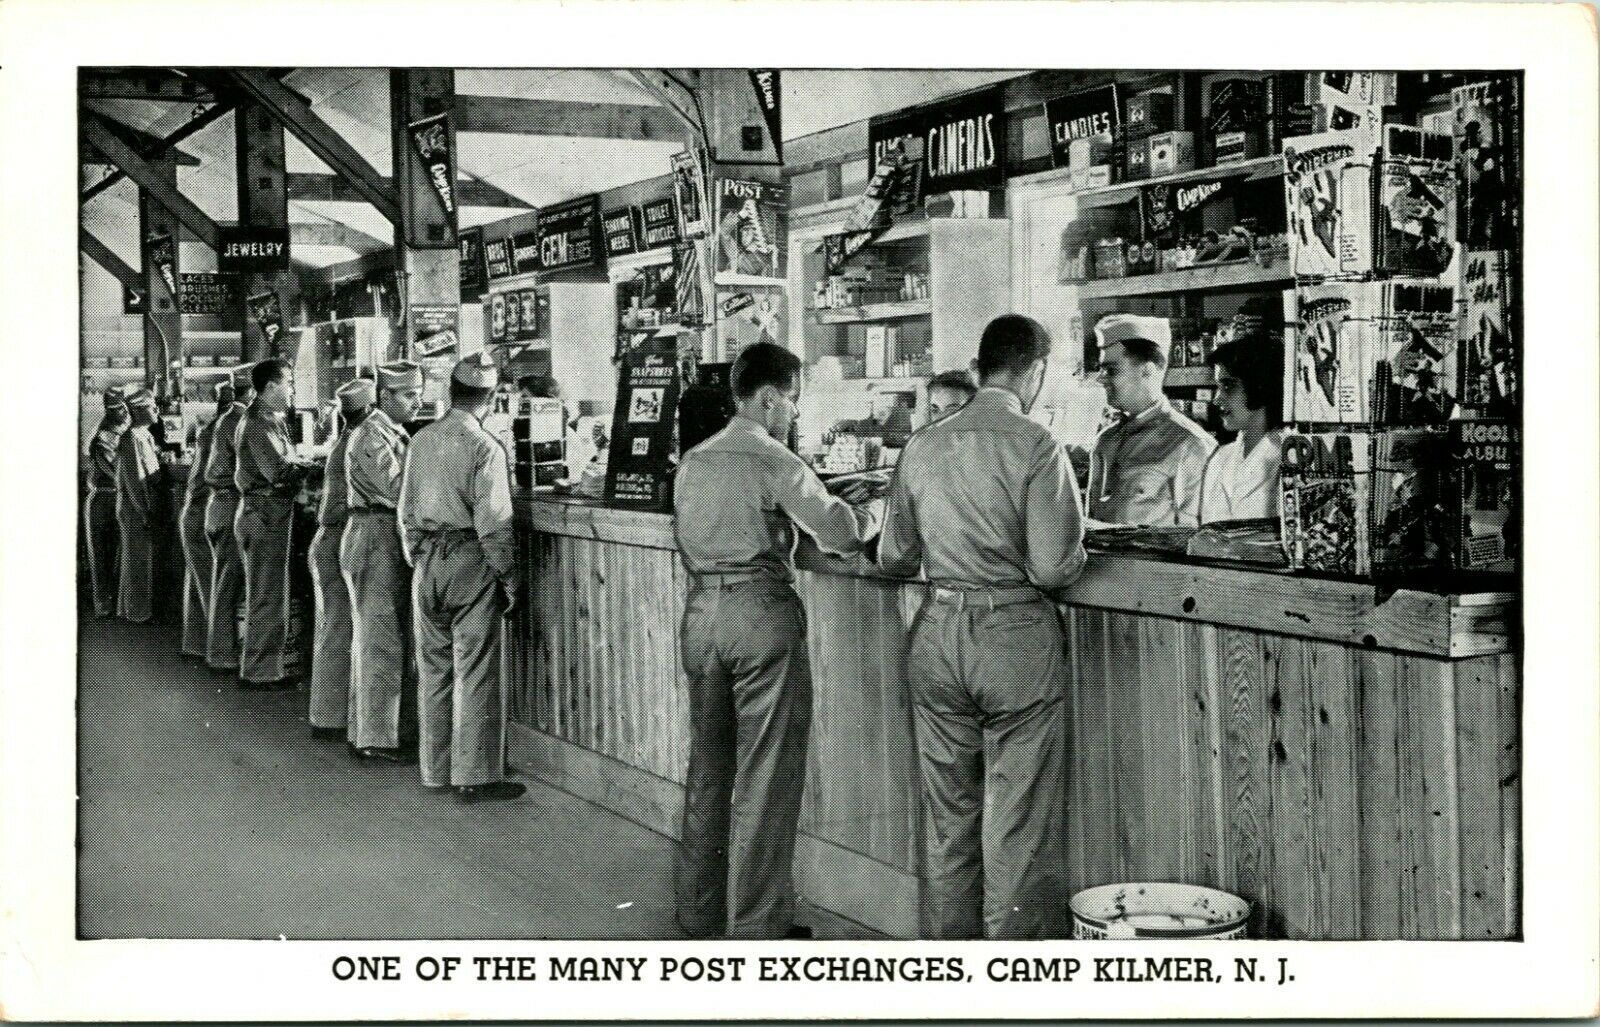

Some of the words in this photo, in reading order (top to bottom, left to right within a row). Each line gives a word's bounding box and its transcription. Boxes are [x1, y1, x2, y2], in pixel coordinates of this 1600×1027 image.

[1055, 112, 1110, 143] CANDIES
[928, 113, 995, 177] CAMERAS
[724, 178, 763, 200] POST
[647, 203, 670, 222] TOILET
[605, 215, 630, 234] SHAVING
[610, 234, 630, 251] NEEDS
[647, 225, 676, 244] ARTICLES
[223, 243, 284, 257] JEWELRY
[541, 231, 568, 267] GEM
[180, 274, 215, 284] LACES
[180, 284, 228, 293] BRUSHES
[180, 294, 233, 303] POLISHE
[1281, 435, 1354, 474] CRIME
[1462, 445, 1508, 461] ALBU
